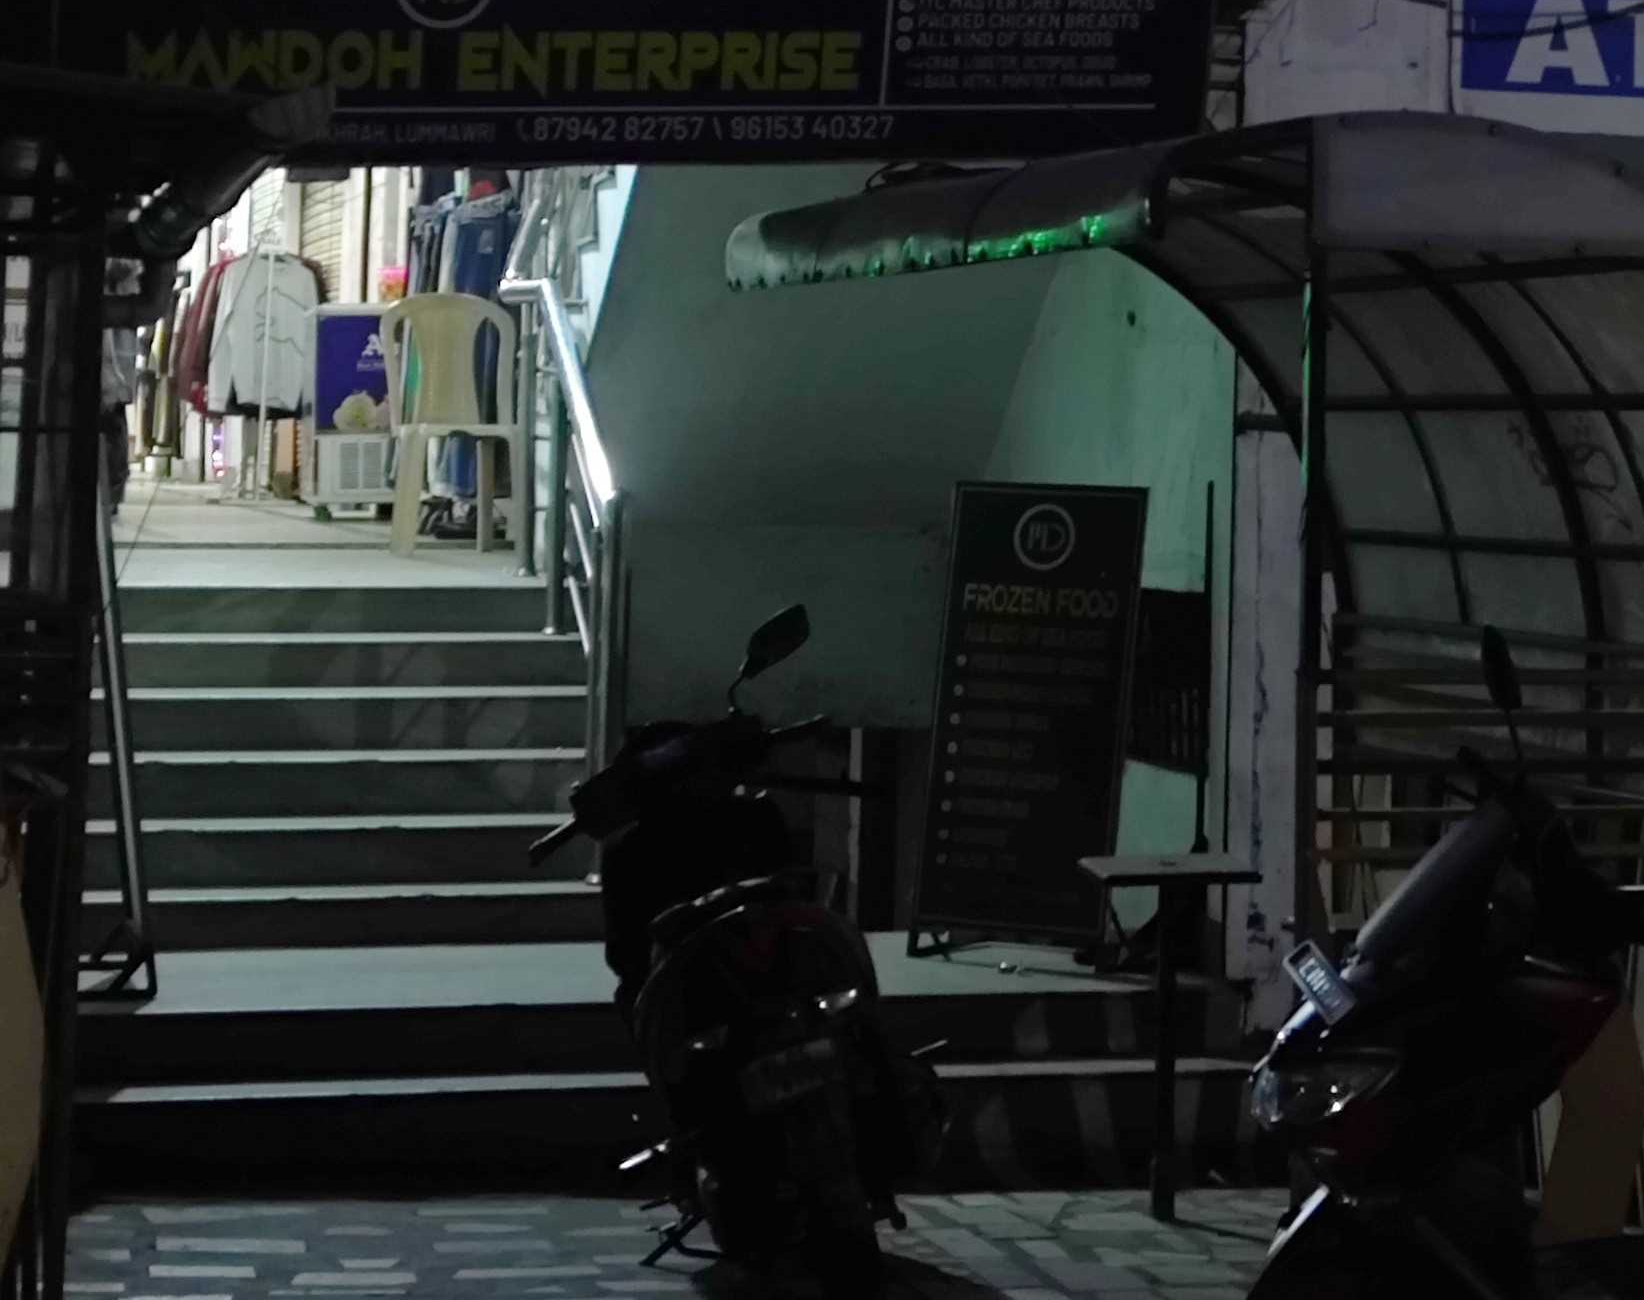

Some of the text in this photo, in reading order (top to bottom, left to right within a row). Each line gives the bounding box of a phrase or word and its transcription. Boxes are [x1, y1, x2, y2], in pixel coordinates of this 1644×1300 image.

[126, 21, 864, 98] MAWDOH ENTERPRISE
[533, 114, 620, 143] 87942
[623, 113, 704, 143] 82757
[728, 112, 805, 141] 96153
[809, 110, 895, 140] 40327
[962, 581, 1119, 620] FROZEN FOOD
